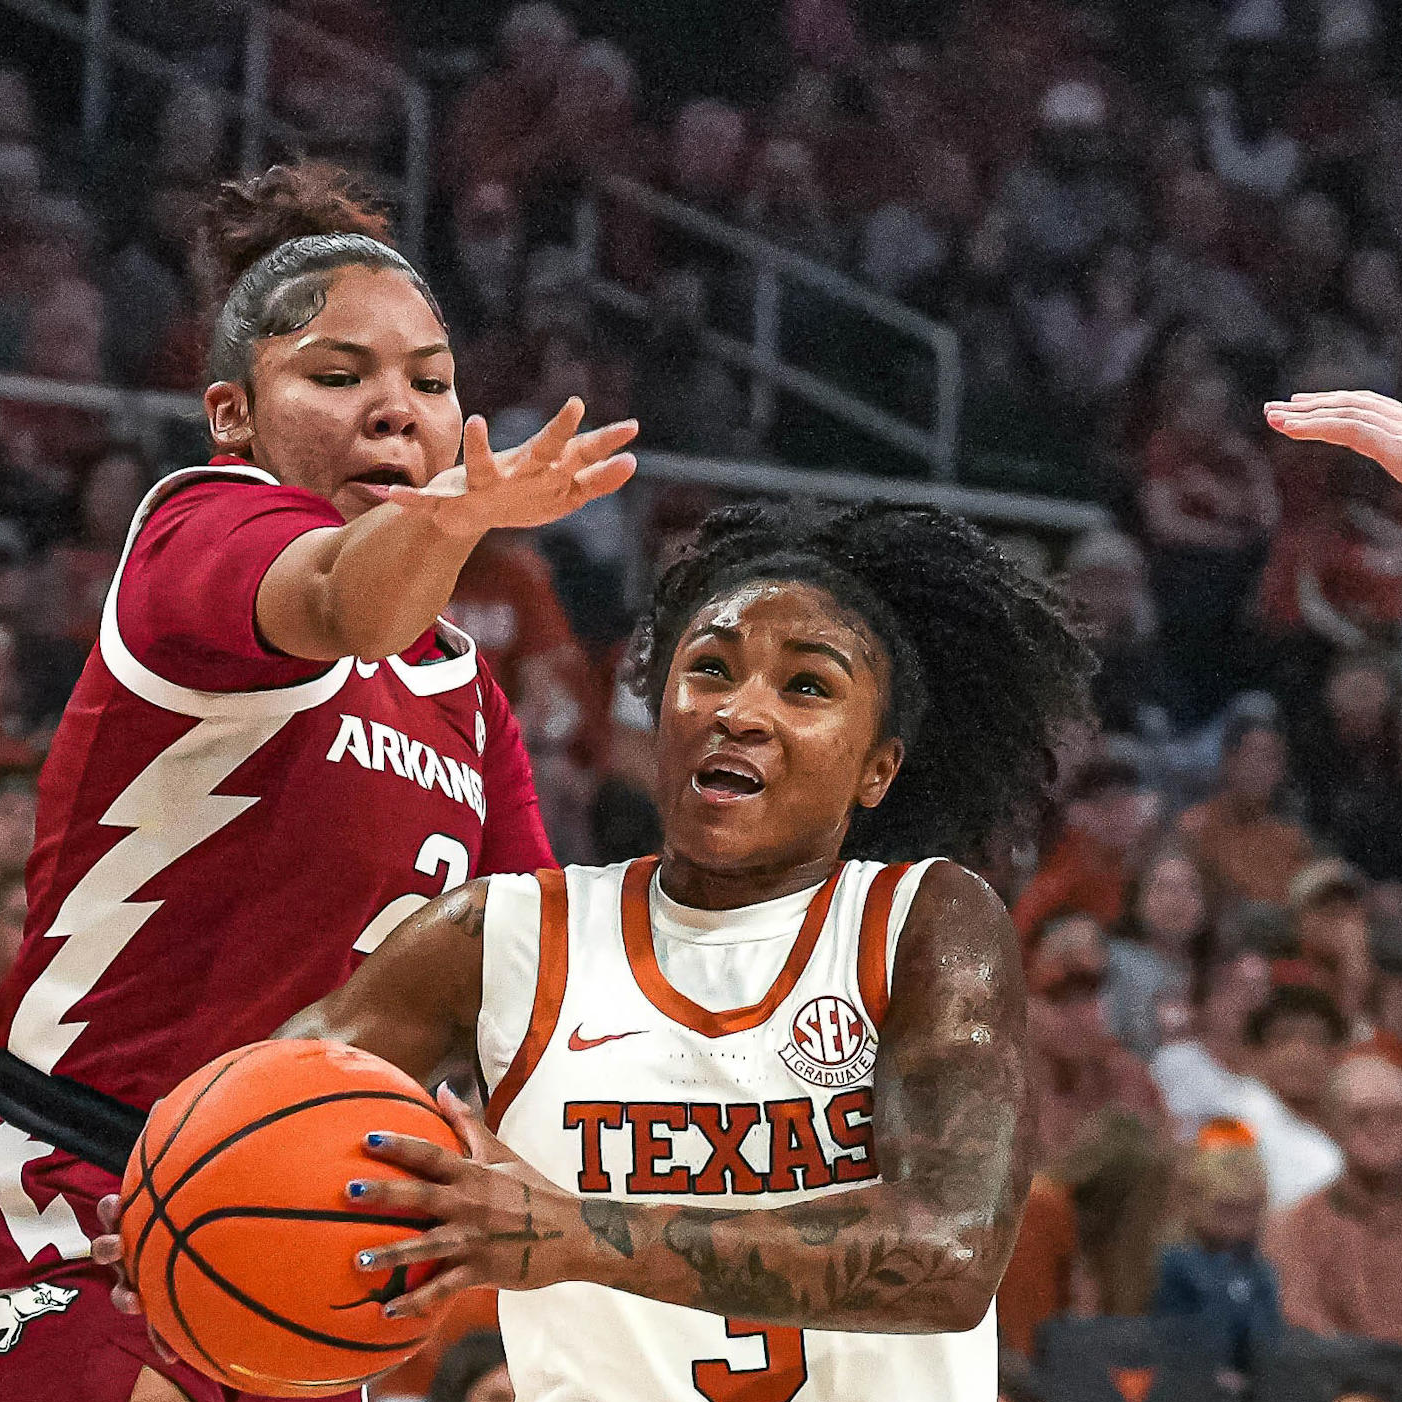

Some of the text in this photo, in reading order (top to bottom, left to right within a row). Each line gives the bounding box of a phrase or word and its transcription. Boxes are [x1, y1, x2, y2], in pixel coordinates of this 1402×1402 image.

[797, 997, 860, 1064] SEC
[794, 1055, 871, 1085] GRADUATE
[563, 1087, 880, 1195] TEXAS
